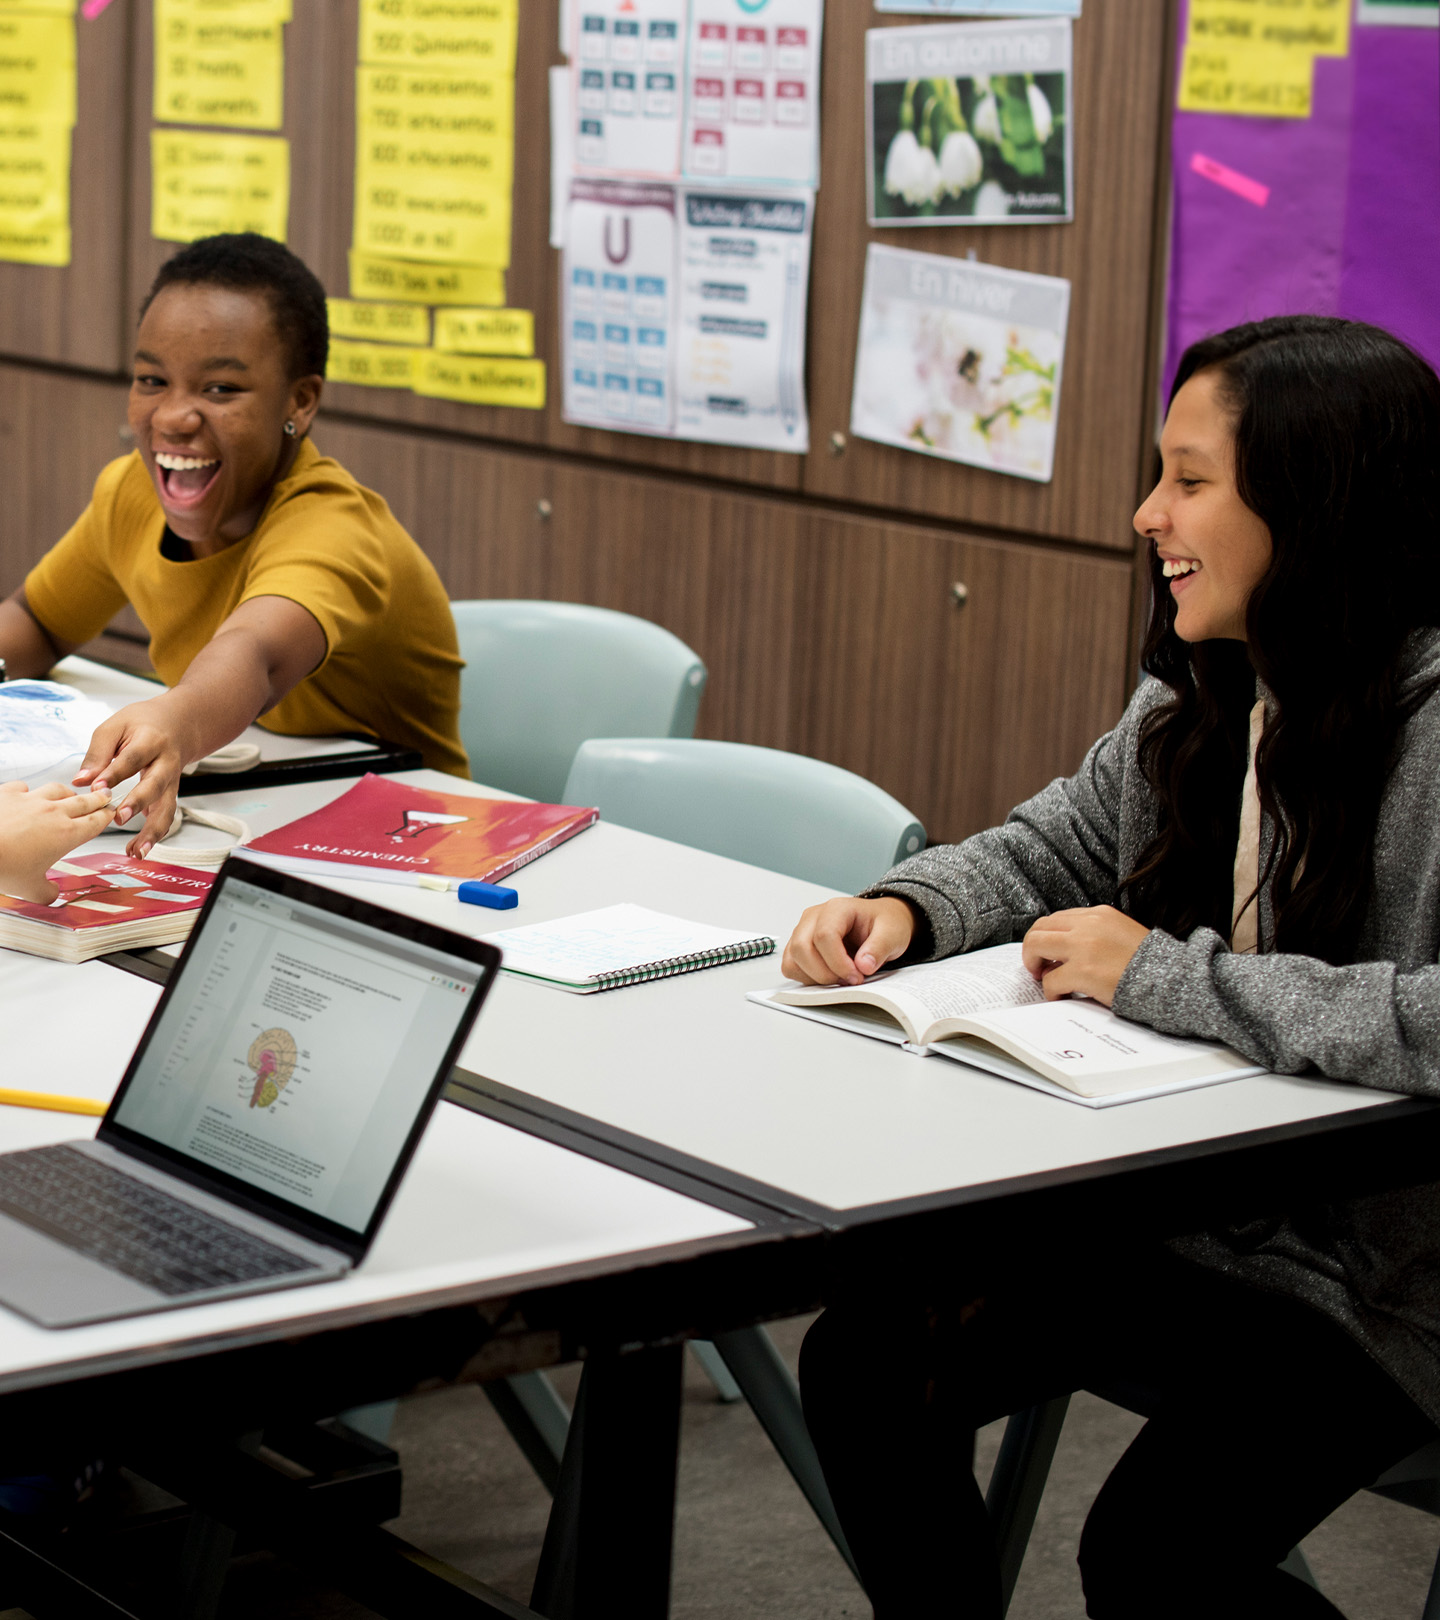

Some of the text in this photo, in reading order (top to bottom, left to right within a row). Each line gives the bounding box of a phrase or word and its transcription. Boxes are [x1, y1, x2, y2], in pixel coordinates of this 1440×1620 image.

[883, 34, 1051, 70] En automne
[605, 216, 631, 264] U
[293, 843, 430, 865] CHEMISTRY
